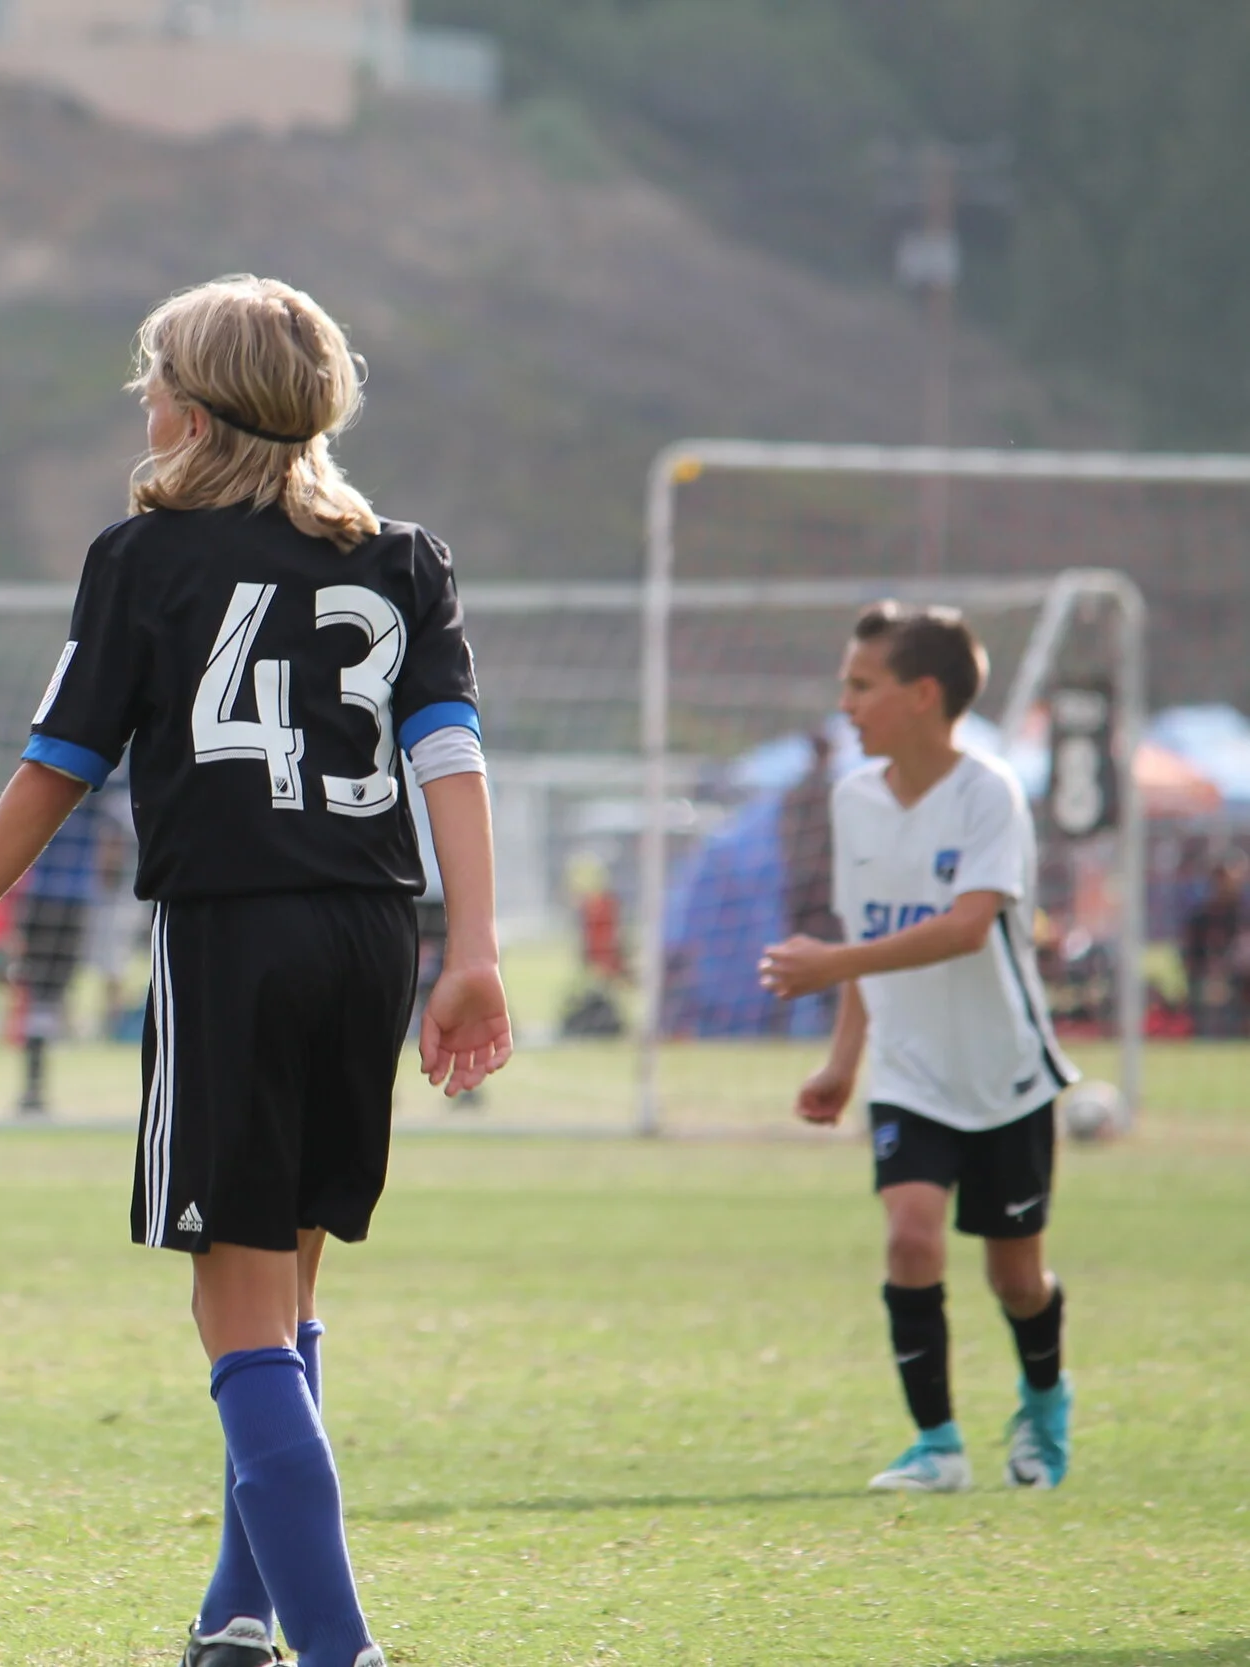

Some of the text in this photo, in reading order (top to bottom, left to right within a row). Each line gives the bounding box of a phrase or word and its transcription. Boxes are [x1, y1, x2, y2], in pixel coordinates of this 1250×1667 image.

[191, 582, 407, 817] 43
[860, 900, 954, 939] SU
[177, 1220, 203, 1233] adida
